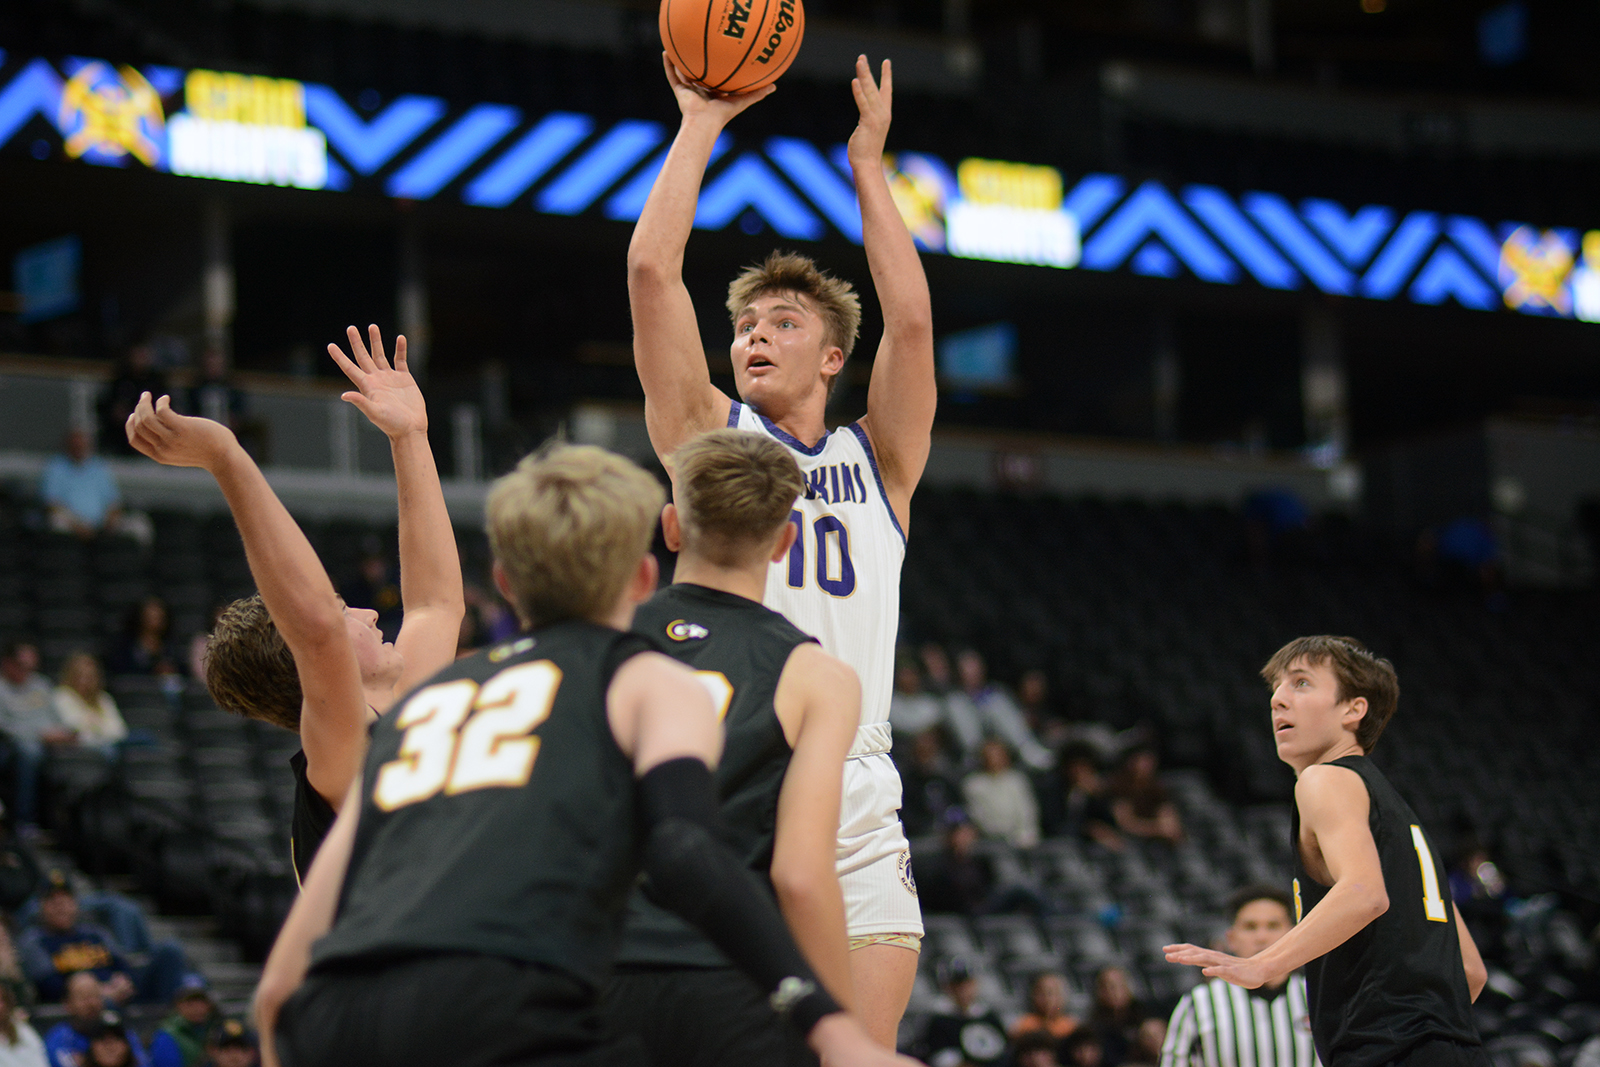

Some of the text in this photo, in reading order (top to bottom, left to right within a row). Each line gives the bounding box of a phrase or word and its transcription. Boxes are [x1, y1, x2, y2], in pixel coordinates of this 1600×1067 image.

[755, 0, 795, 64] ilson
[786, 508, 857, 599] 10
[373, 659, 564, 813] 32
[1410, 824, 1448, 923] 1
